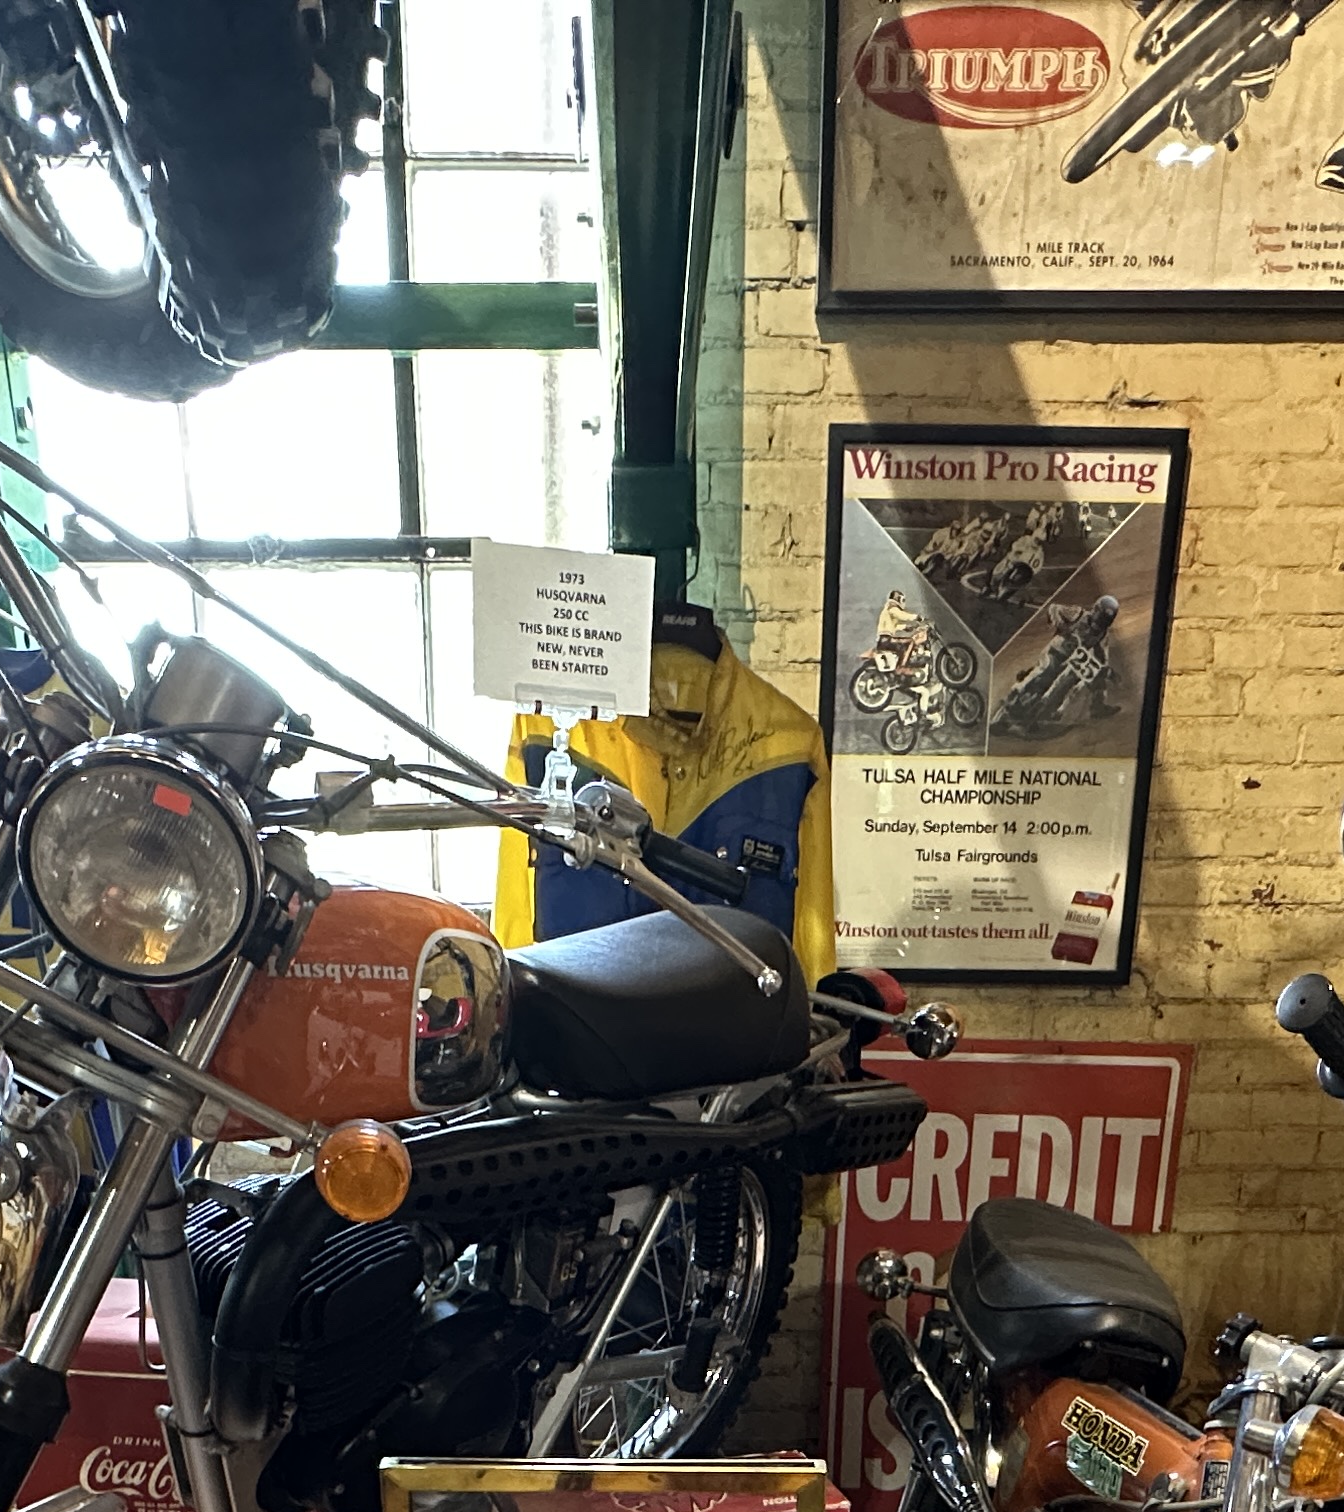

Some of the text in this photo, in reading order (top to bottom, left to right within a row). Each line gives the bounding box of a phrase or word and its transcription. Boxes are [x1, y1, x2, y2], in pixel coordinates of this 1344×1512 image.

[866, 38, 1106, 94] TRIUMPH
[1026, 242, 1105, 253] 1 MILE TRACK
[950, 256, 1036, 268] SACRAMENTO,
[1089, 256, 1118, 267] SEPT.
[1148, 256, 1174, 267] 1964
[1329, 276, 1344, 286] The
[846, 448, 1158, 494] Winston Pro Racing
[559, 572, 585, 585] 1973
[536, 587, 606, 605] HUSQVARNA
[553, 608, 589, 621] 250 CC
[519, 622, 622, 642] THIS BIKE IS BRAND
[537, 641, 604, 658] NEW, NEVER
[532, 658, 609, 676] BEEN STARTED
[862, 768, 1102, 787] TULSA HALF MILE NATIONAL
[920, 789, 1042, 805] CHAMPIONSHIP
[864, 819, 1093, 837] Sunday, September 14 2:00 p.m.
[915, 849, 1038, 865] Tulsa Fairgrounds
[1064, 910, 1101, 926] Winston
[982, 922, 1053, 940] them all.
[856, 1112, 1162, 1226] CREDIT
[113, 1435, 162, 1447] DRINK
[1065, 1402, 1147, 1470] HONDA
